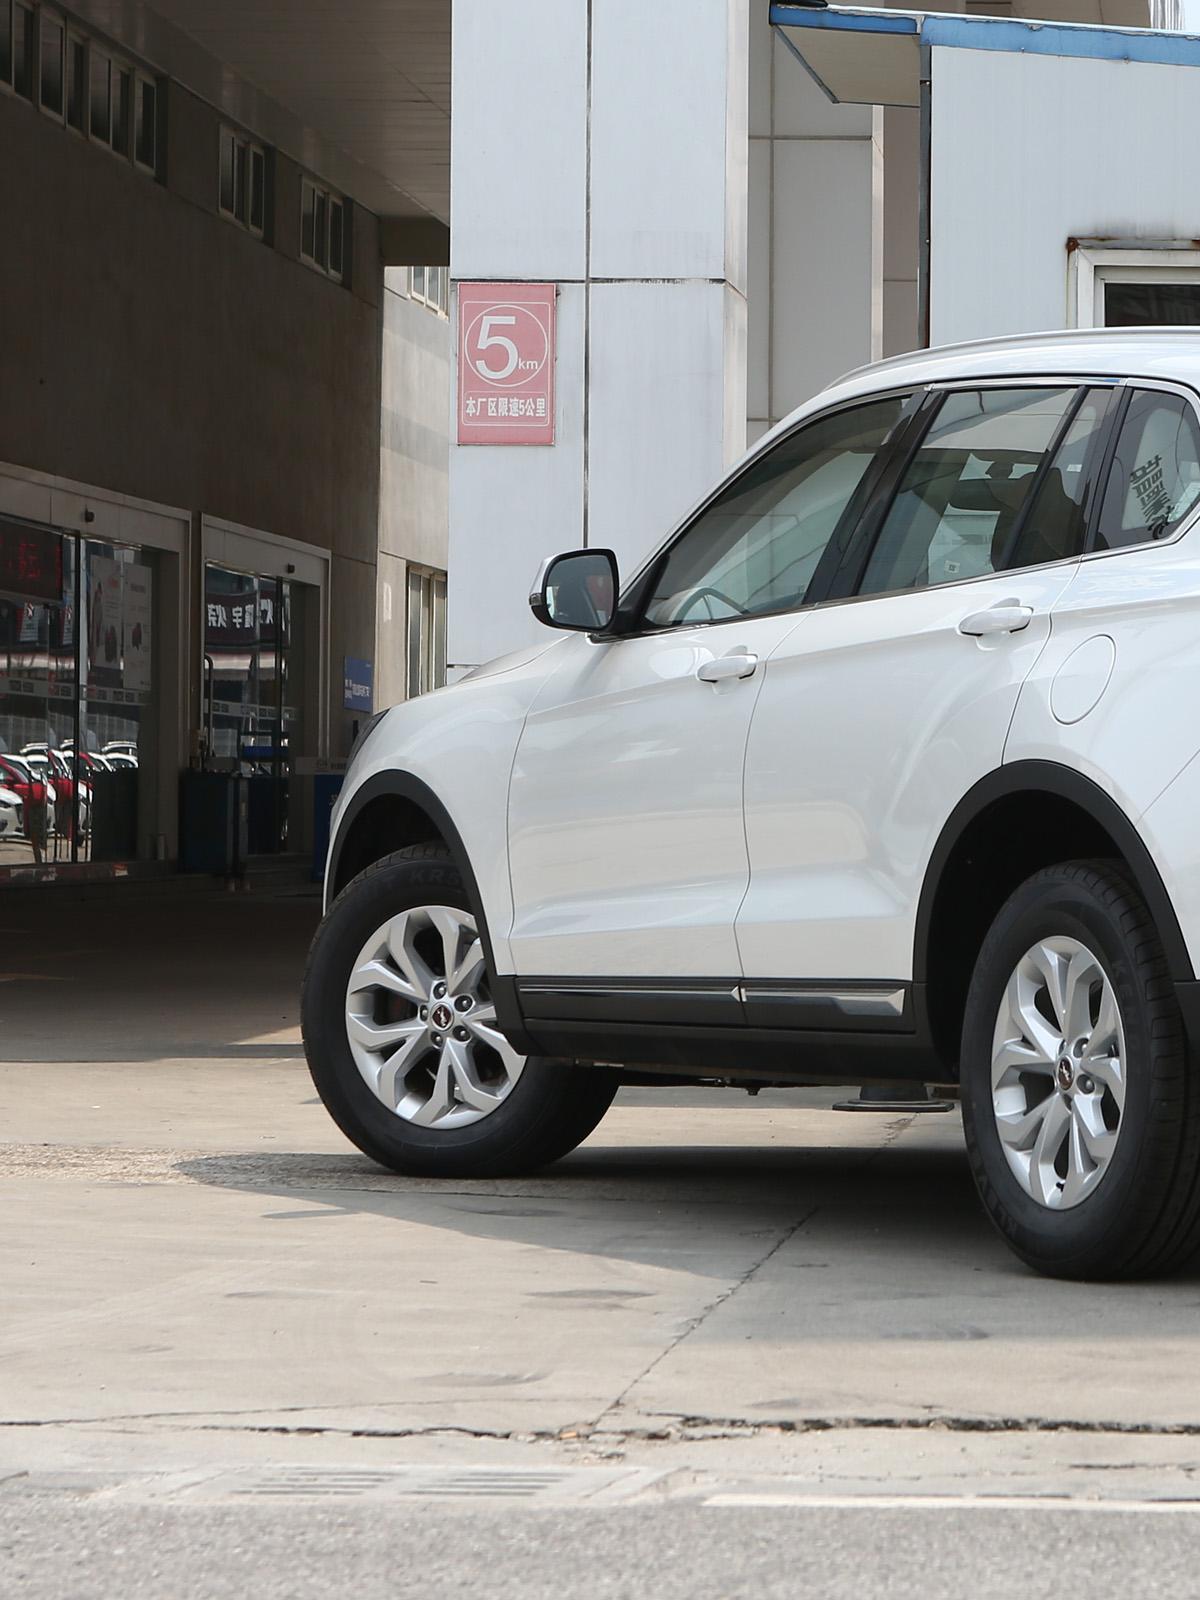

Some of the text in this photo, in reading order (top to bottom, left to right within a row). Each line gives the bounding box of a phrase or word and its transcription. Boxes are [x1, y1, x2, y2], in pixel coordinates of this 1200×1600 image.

[475, 315, 538, 379] 5 km
[466, 396, 546, 417] 本厂区限速5公里
